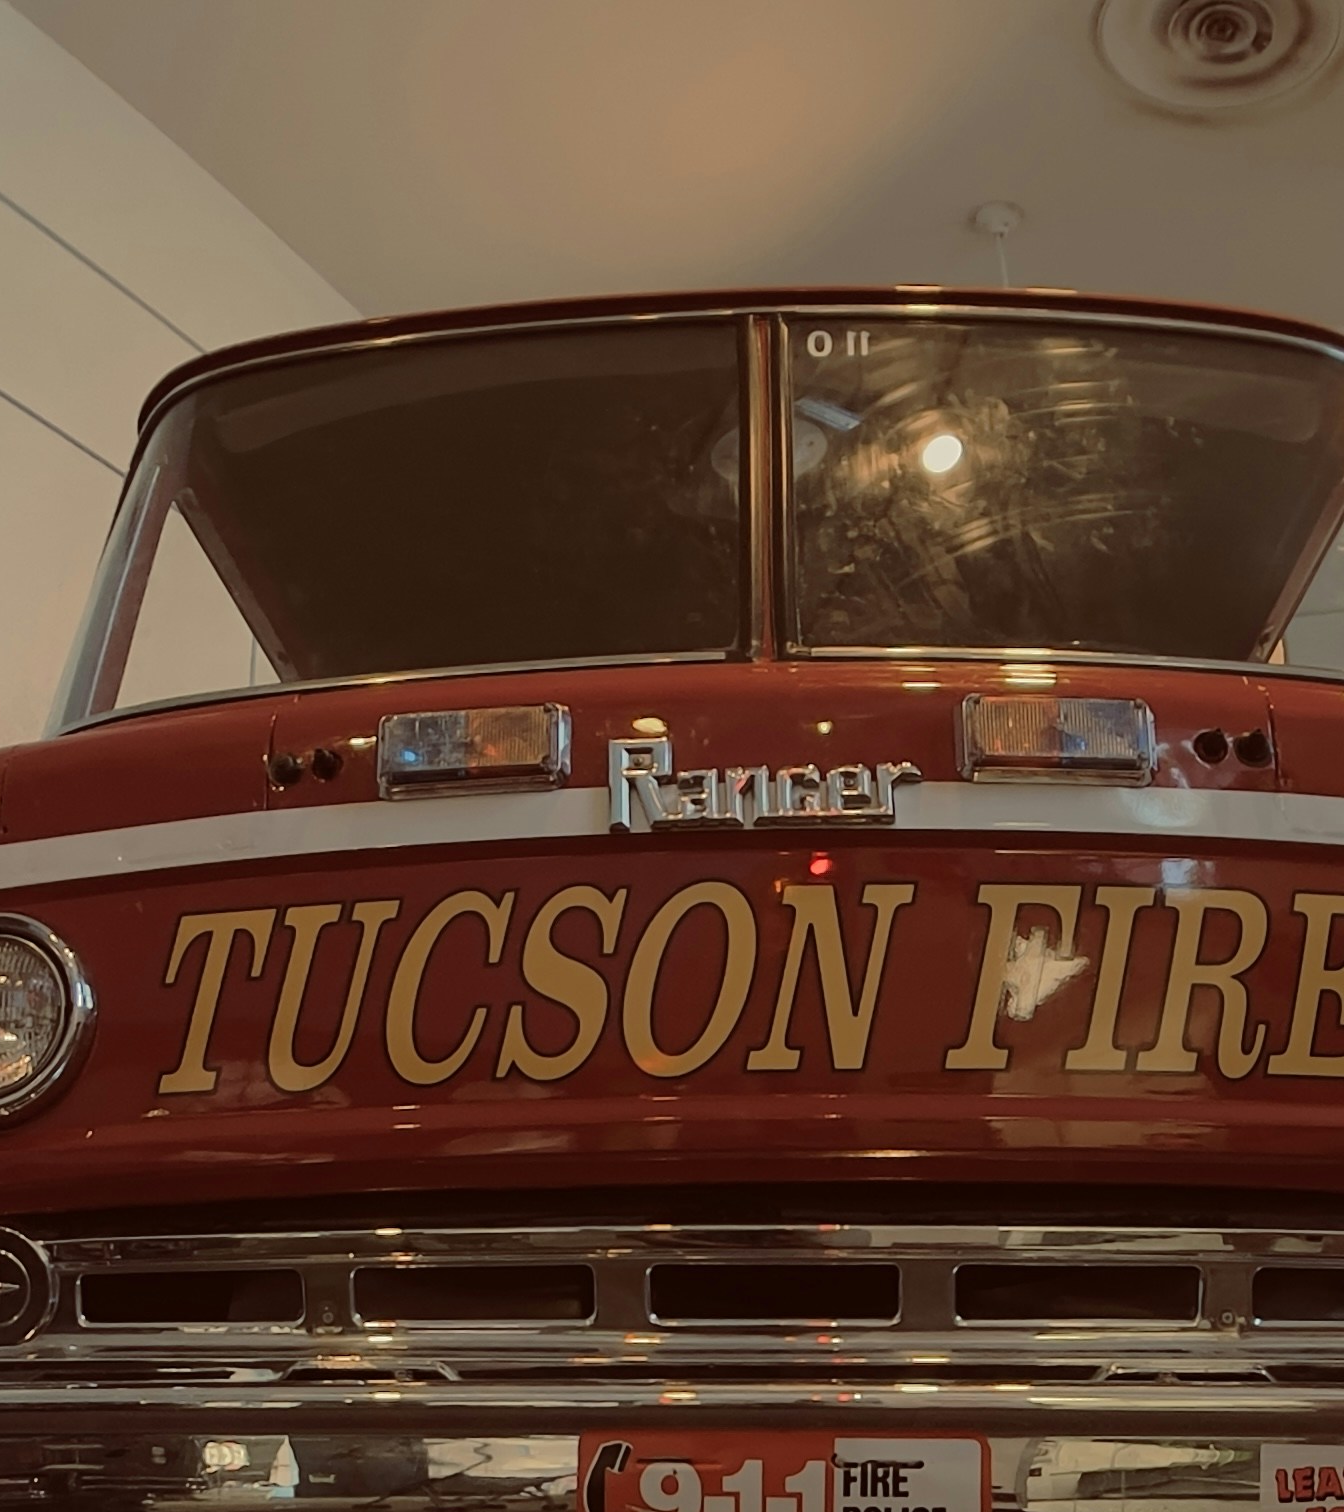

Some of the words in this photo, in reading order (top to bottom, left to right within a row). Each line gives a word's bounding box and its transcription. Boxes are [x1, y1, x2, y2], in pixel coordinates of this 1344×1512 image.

[609, 737, 922, 834] Ranger
[158, 881, 915, 1093] TUCSON
[842, 1462, 909, 1498] FIRE
